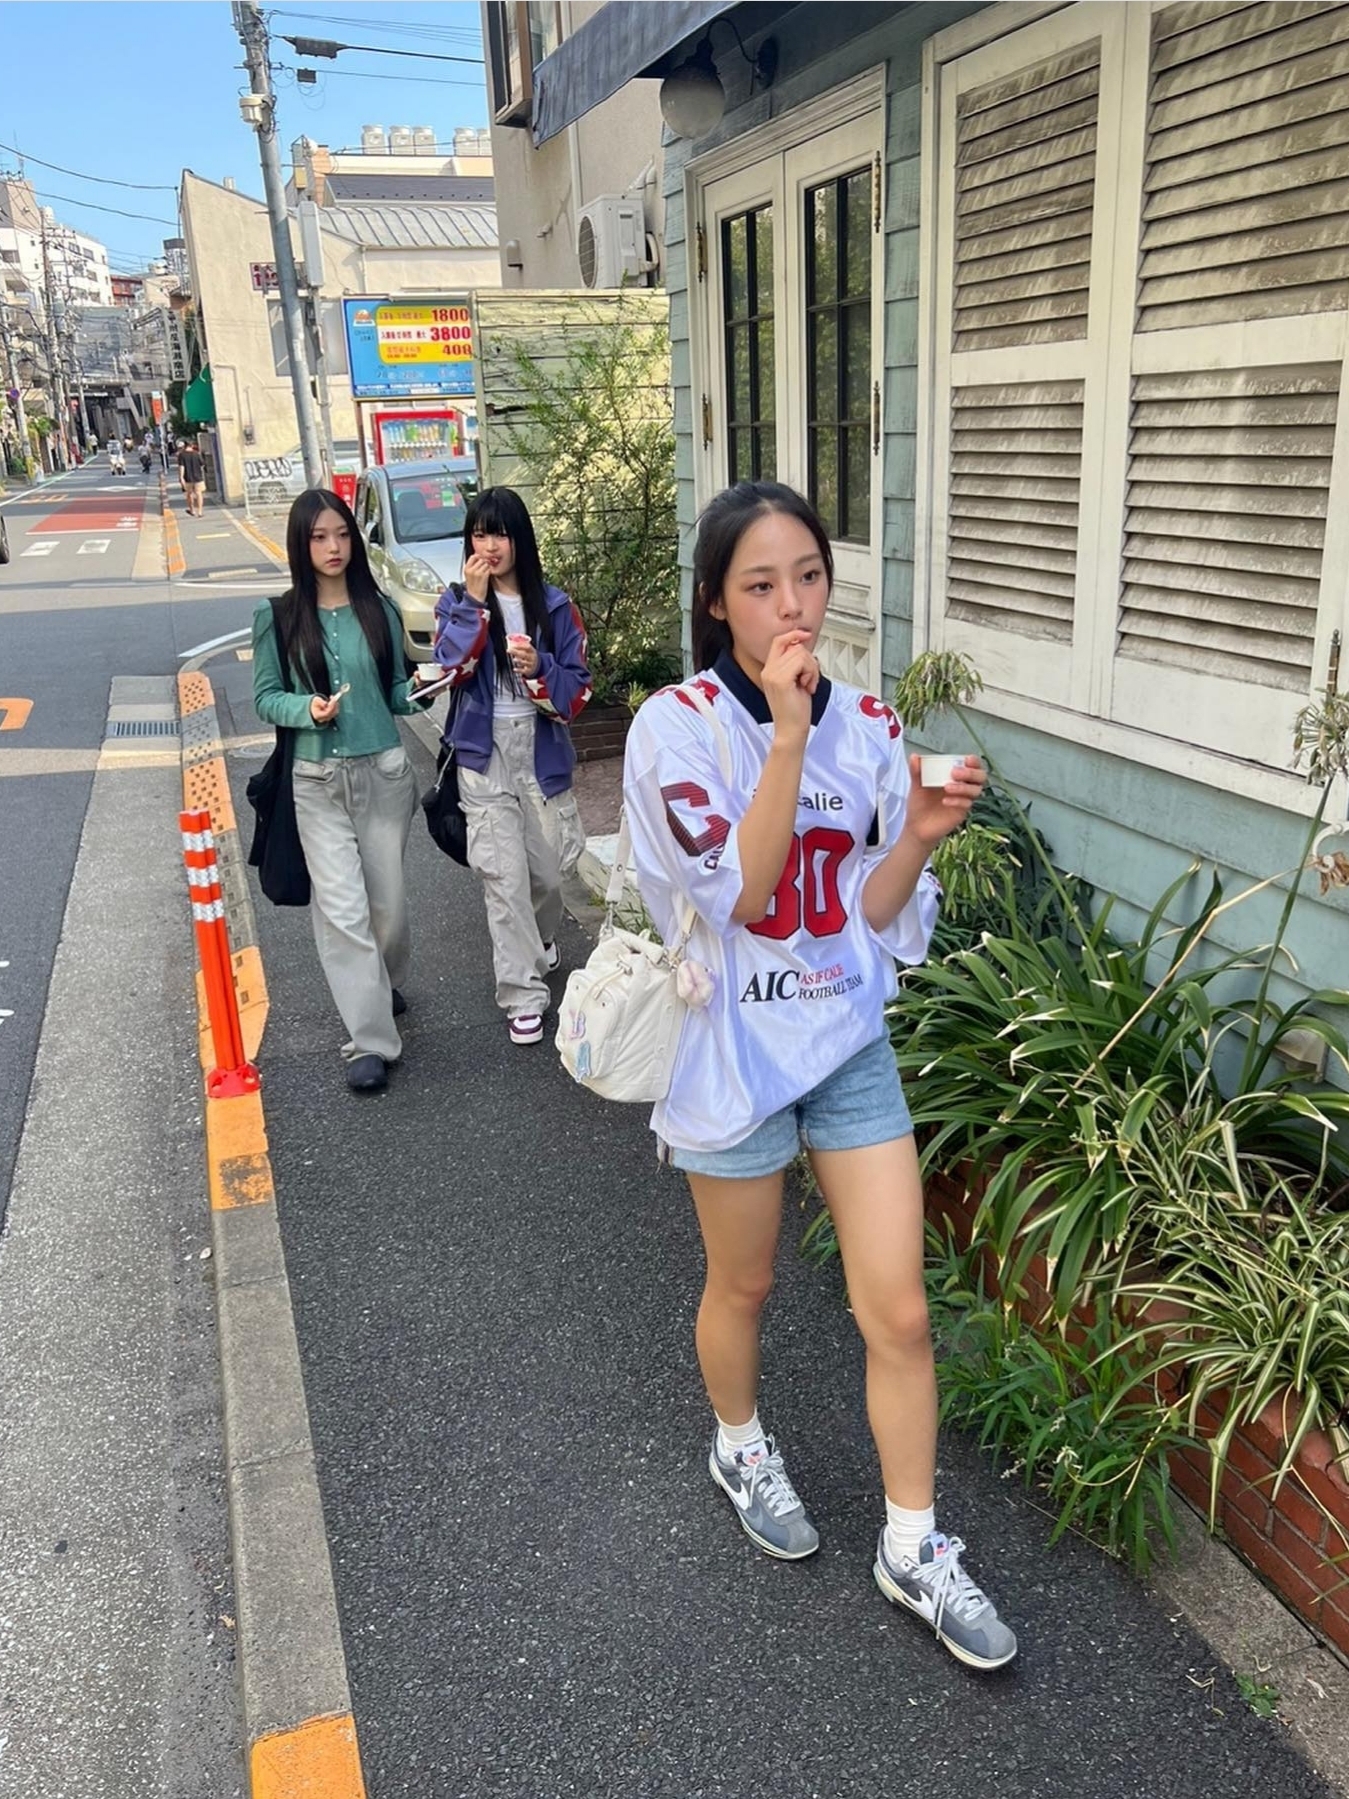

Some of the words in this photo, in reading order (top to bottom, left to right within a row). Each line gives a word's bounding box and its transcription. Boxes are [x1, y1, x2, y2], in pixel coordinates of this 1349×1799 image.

[431, 308, 469, 321] 1800
[430, 326, 472, 341] 3800
[798, 792, 843, 811] alie
[739, 969, 800, 1003] AIC
[800, 972, 815, 985] AS
[798, 982, 847, 1000] FOOTBALL
